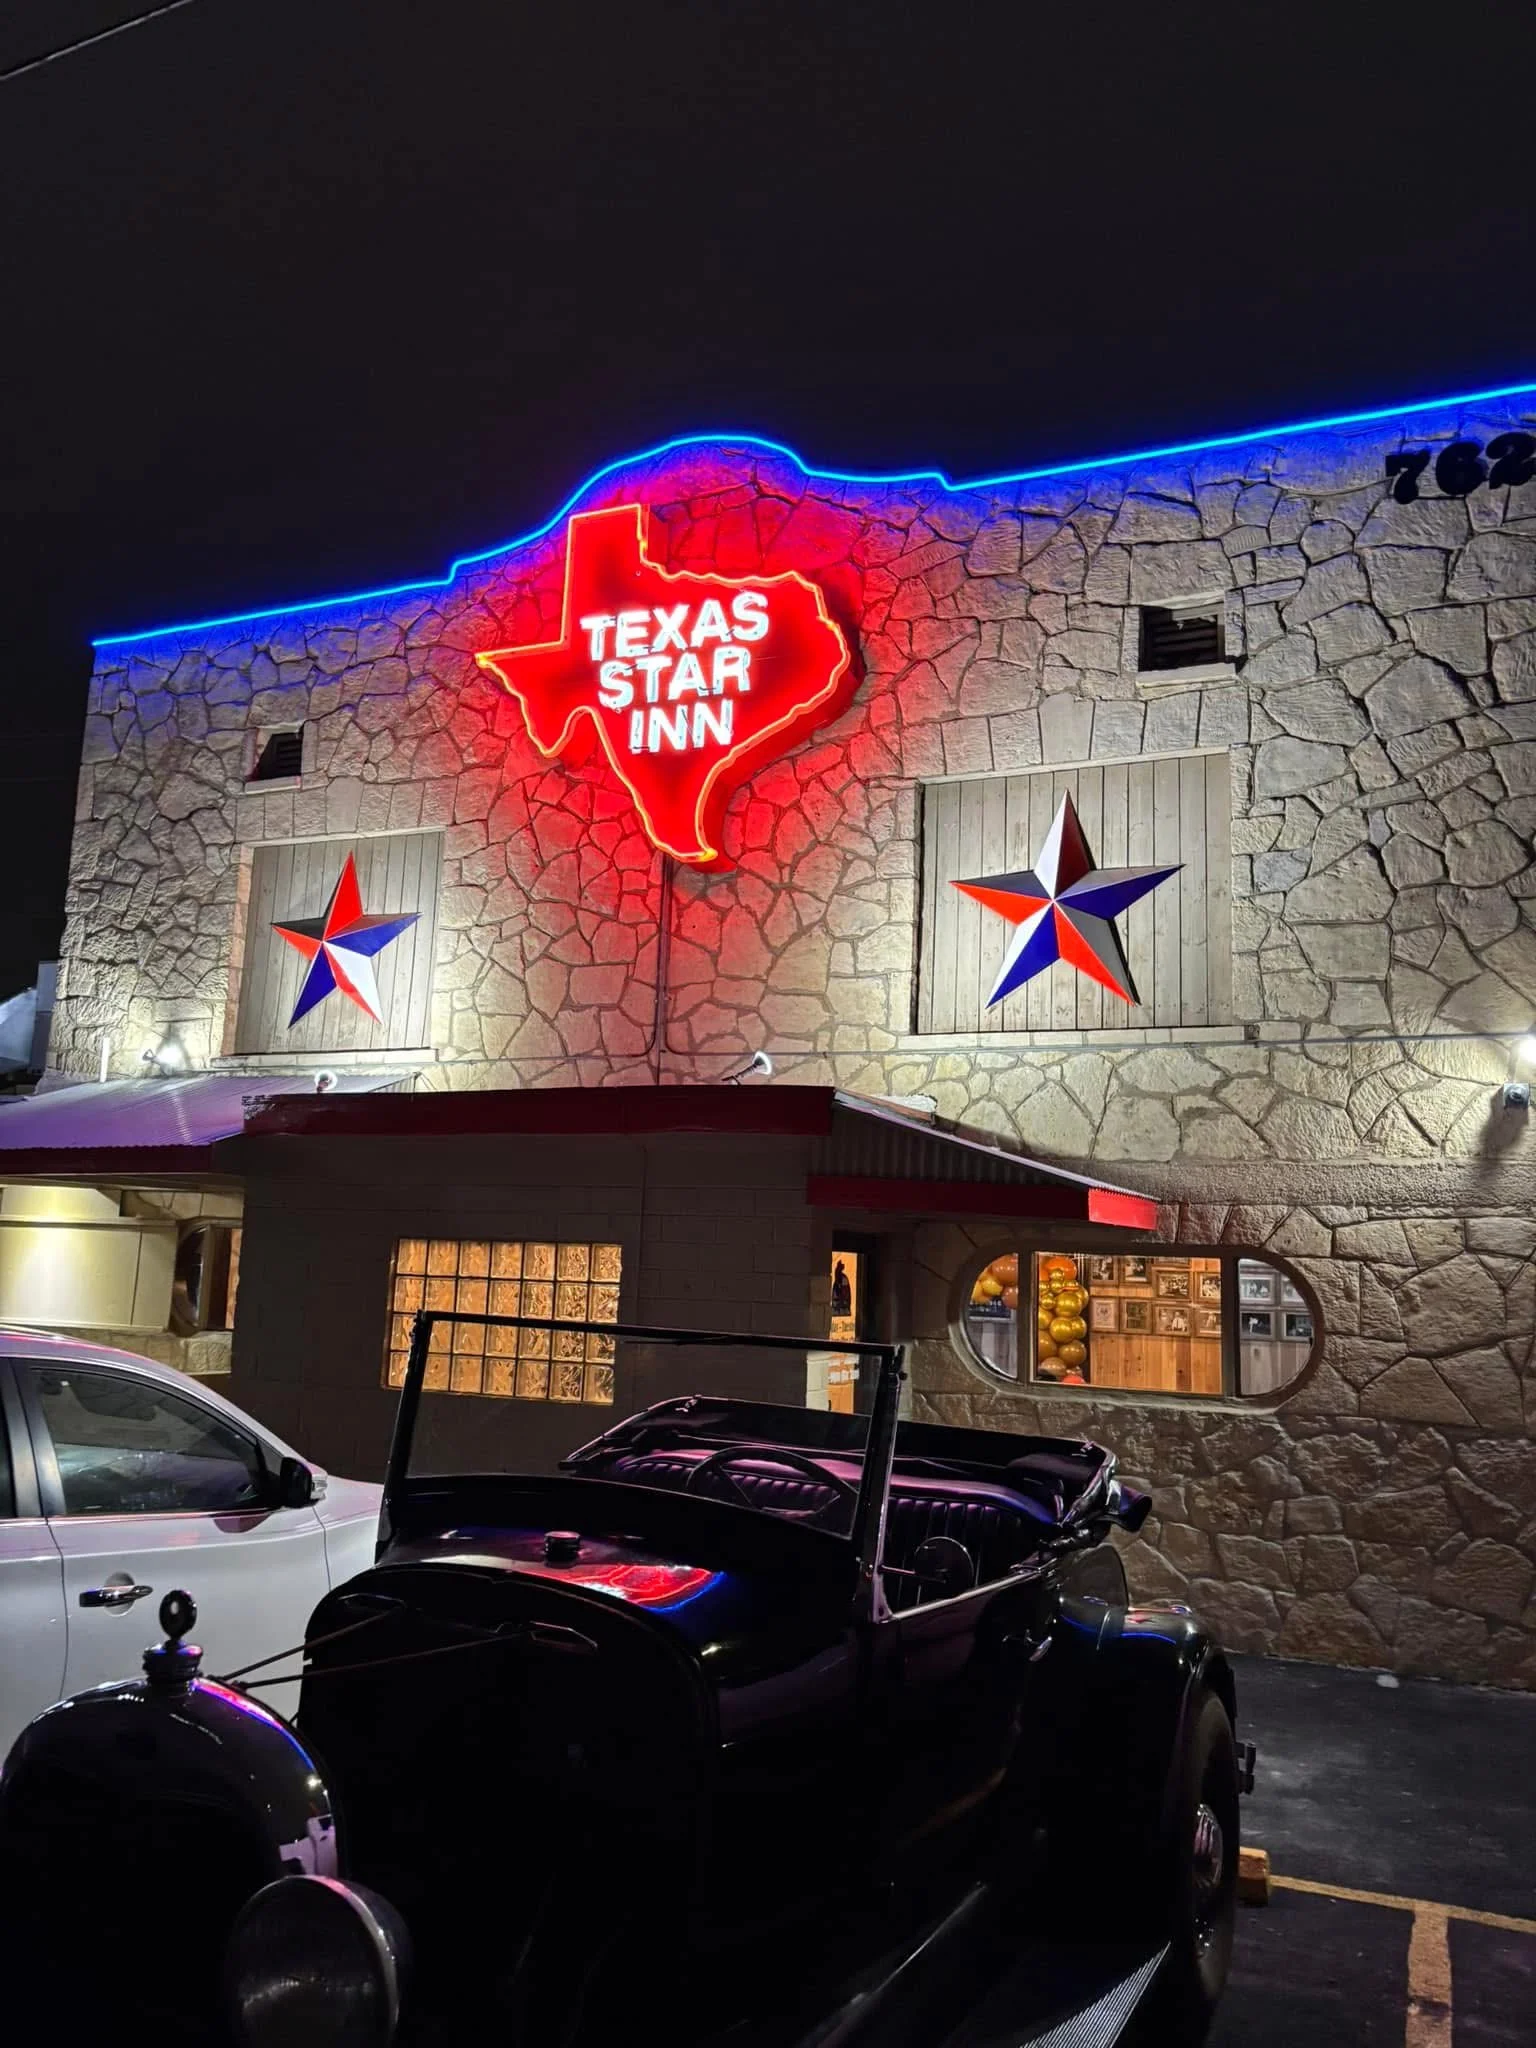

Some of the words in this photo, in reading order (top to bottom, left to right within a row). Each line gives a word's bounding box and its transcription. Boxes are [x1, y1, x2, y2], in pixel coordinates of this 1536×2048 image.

[580, 591, 769, 661] TEXAS
[598, 646, 751, 709] STAR
[629, 699, 734, 754] INN
